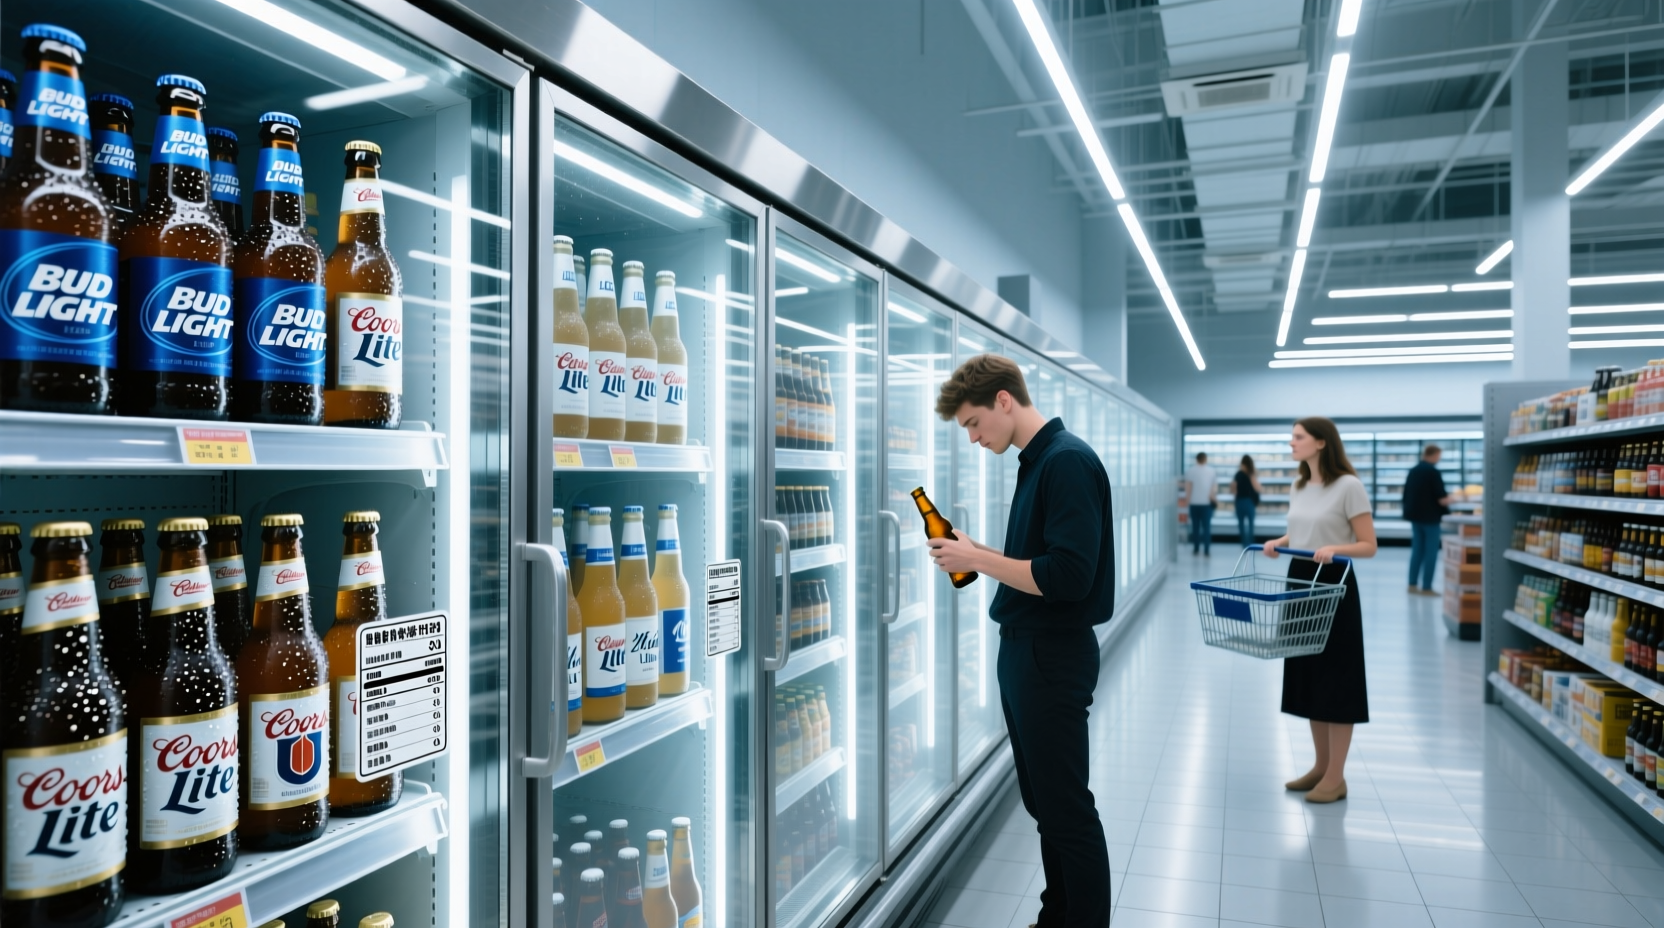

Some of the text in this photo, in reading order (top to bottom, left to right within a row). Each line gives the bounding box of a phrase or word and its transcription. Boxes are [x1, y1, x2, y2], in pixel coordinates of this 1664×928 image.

[26, 100, 89, 125] LIGHT
[38, 87, 86, 110] BUD
[101, 143, 134, 159] BUD
[160, 141, 209, 160] LIGHT
[170, 129, 208, 145] BUD
[271, 160, 302, 175] BUD
[28, 263, 113, 299] BUD
[11, 291, 118, 326] LIGHT
[167, 286, 231, 316] BUD
[151, 309, 234, 339] LIGHT
[271, 304, 326, 330] BUD
[259, 326, 327, 351] LIGHT
[353, 333, 401, 368] Lite
[260, 708, 329, 739] Coors
[153, 734, 238, 772] Coors
[17, 764, 124, 811] Coors
[160, 764, 234, 815] Lite
[26, 801, 119, 859] Lite
